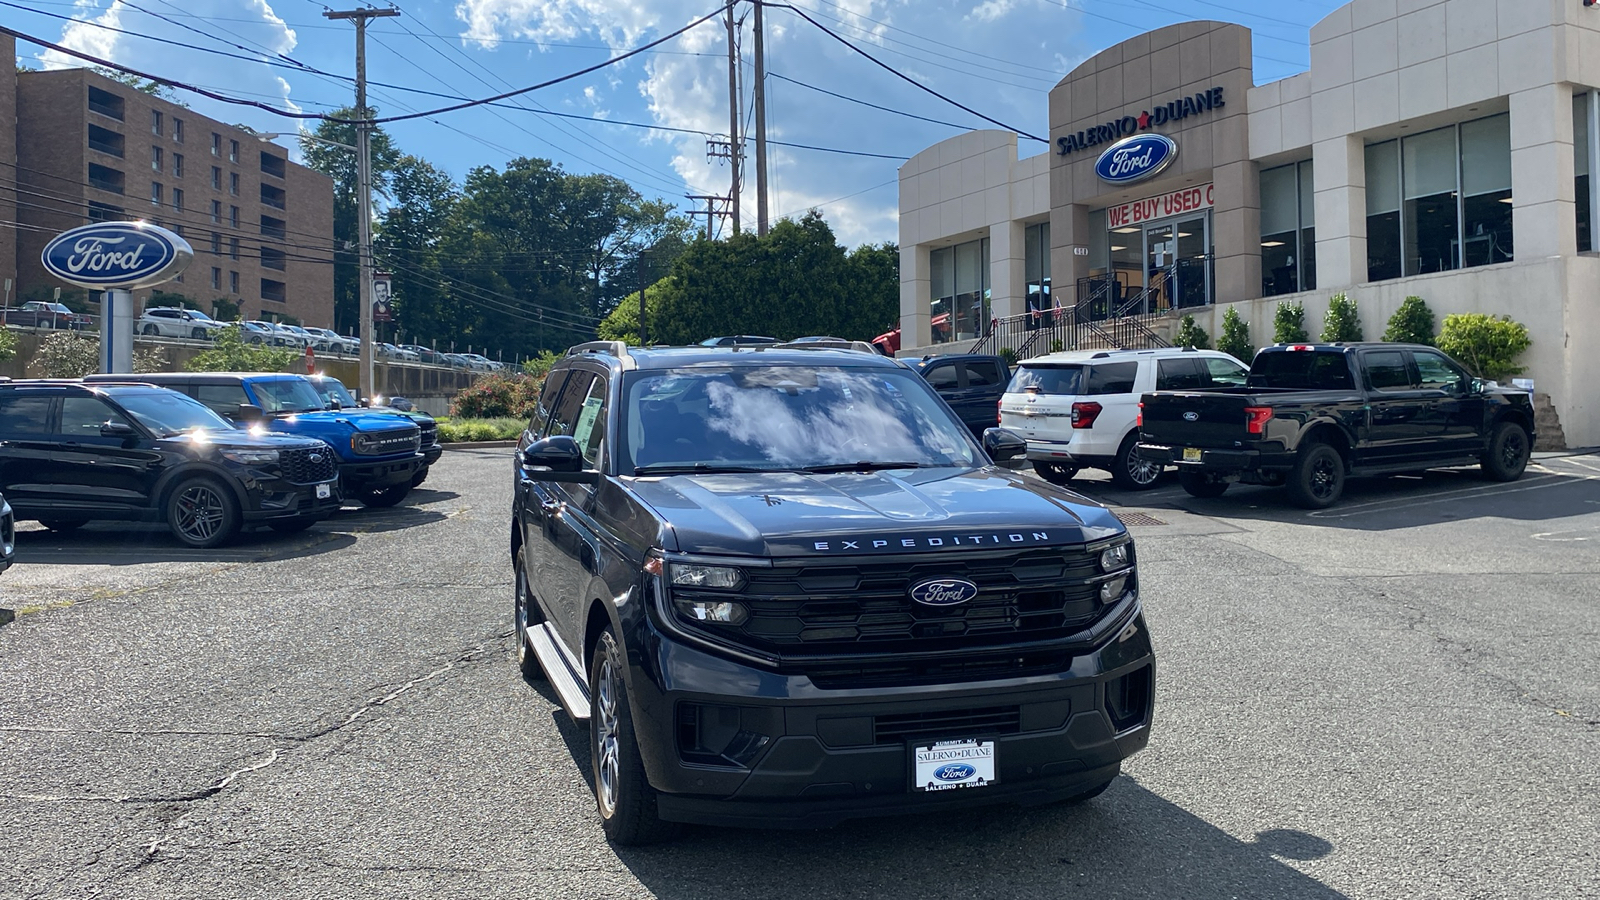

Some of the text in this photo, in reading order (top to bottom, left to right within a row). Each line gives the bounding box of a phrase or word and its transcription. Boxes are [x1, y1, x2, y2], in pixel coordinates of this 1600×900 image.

[1057, 87, 1225, 155] SALERNO DUANE
[1109, 145, 1153, 177] Ford
[1109, 205, 1129, 227] WE
[1133, 198, 1160, 222] BUY
[1164, 188, 1202, 215] USED
[67, 236, 146, 273] Ford
[814, 531, 1049, 550] EXPEDITION
[924, 583, 965, 602] Ford
[917, 748, 991, 761] SALERNO DUANE
[941, 766, 968, 779] Ford
